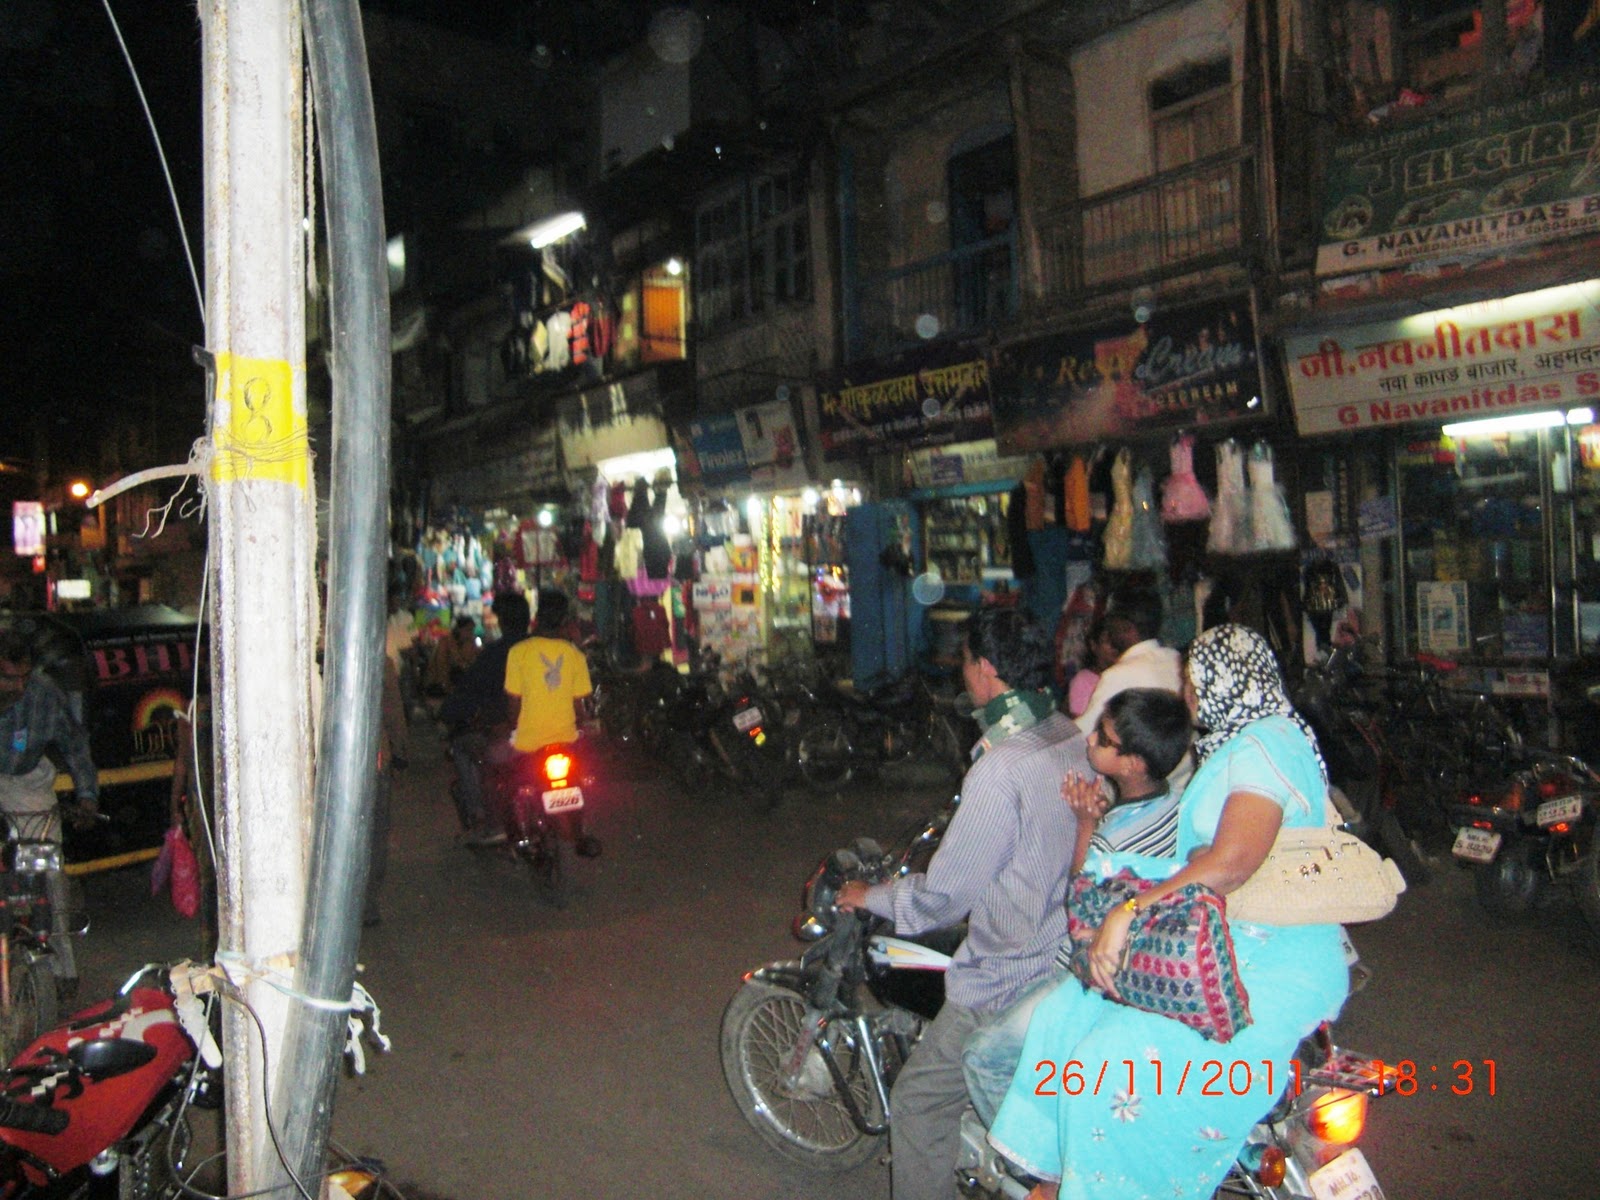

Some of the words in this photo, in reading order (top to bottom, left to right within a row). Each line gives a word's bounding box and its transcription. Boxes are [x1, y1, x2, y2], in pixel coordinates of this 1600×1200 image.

[1377, 202, 1569, 251] NAVANITDAS
[242, 376, 273, 446] 8
[1337, 405, 1360, 427] G
[1370, 381, 1562, 423] Navanitdas
